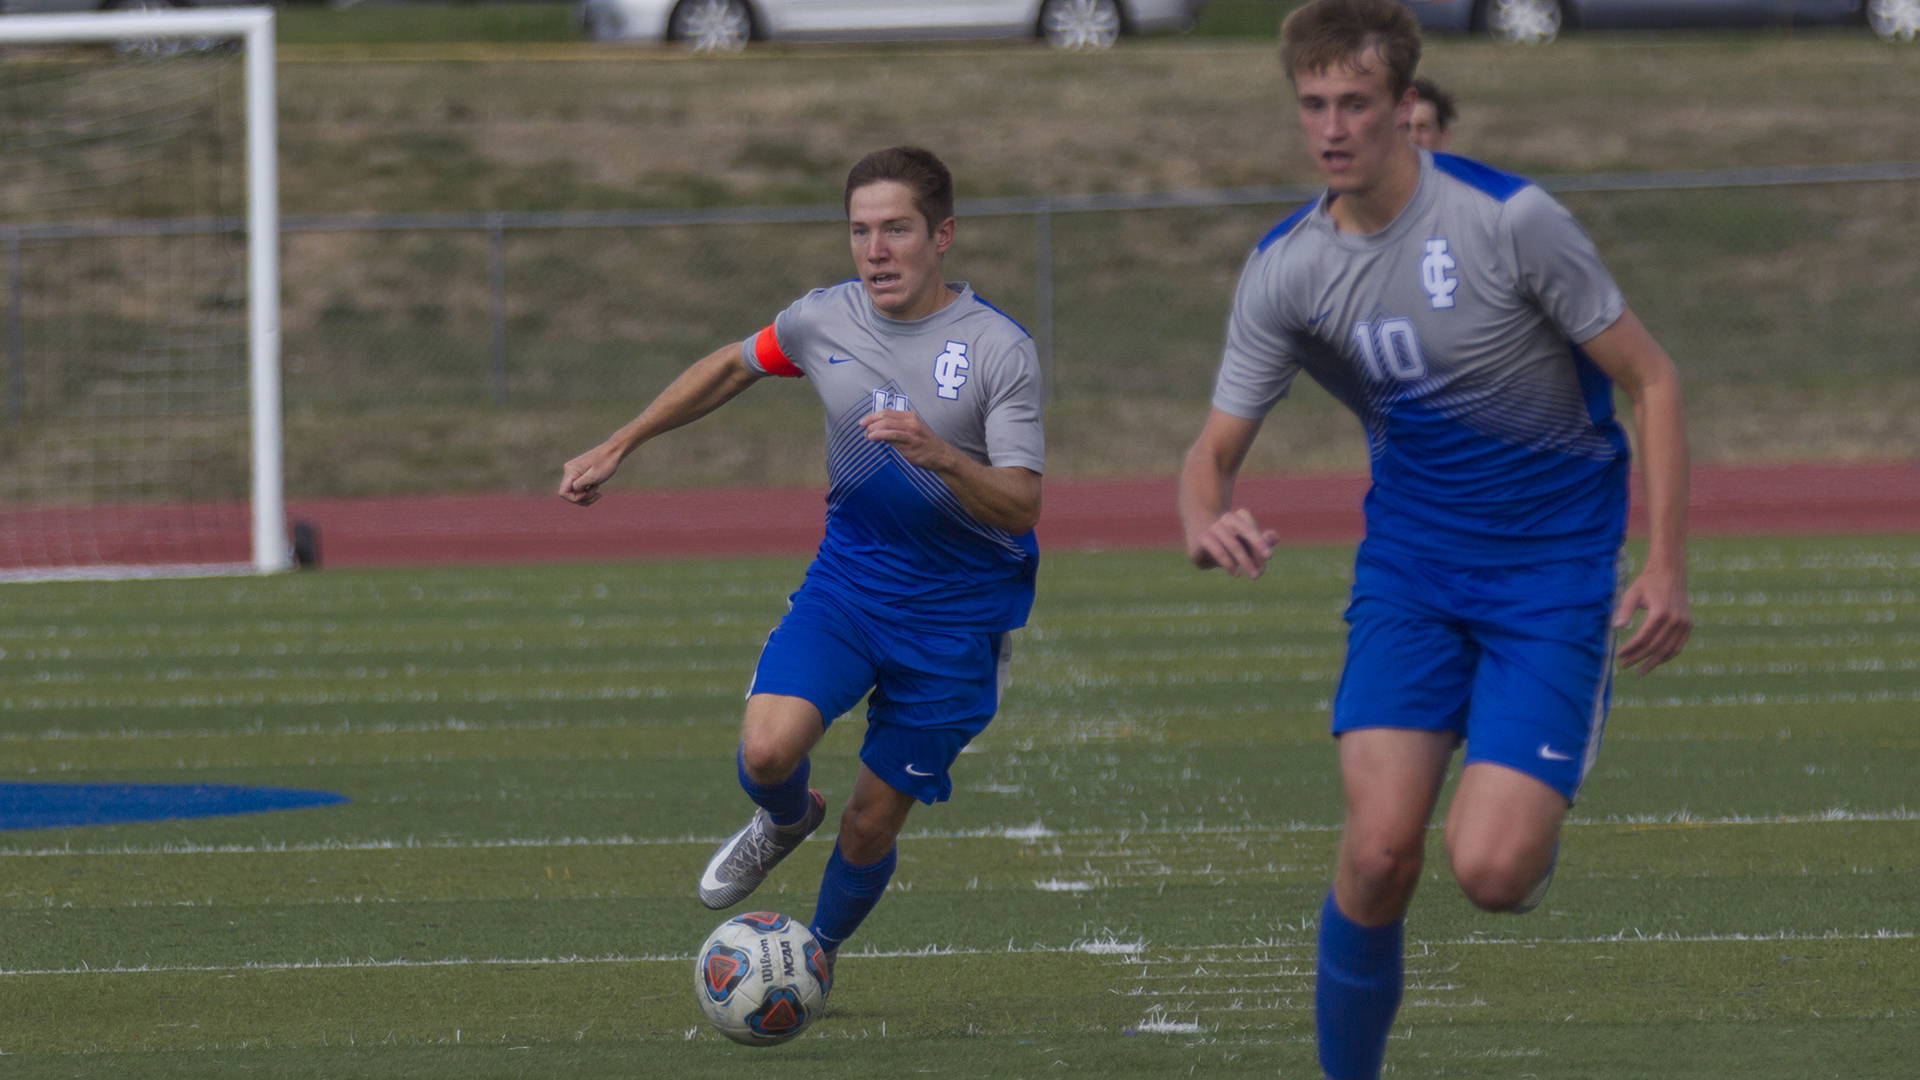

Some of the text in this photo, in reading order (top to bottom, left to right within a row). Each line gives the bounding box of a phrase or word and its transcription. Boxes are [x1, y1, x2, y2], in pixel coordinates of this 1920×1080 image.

[1354, 316, 1427, 382] 10
[760, 938, 774, 984] Wilson
[780, 940, 795, 978] NCAA
